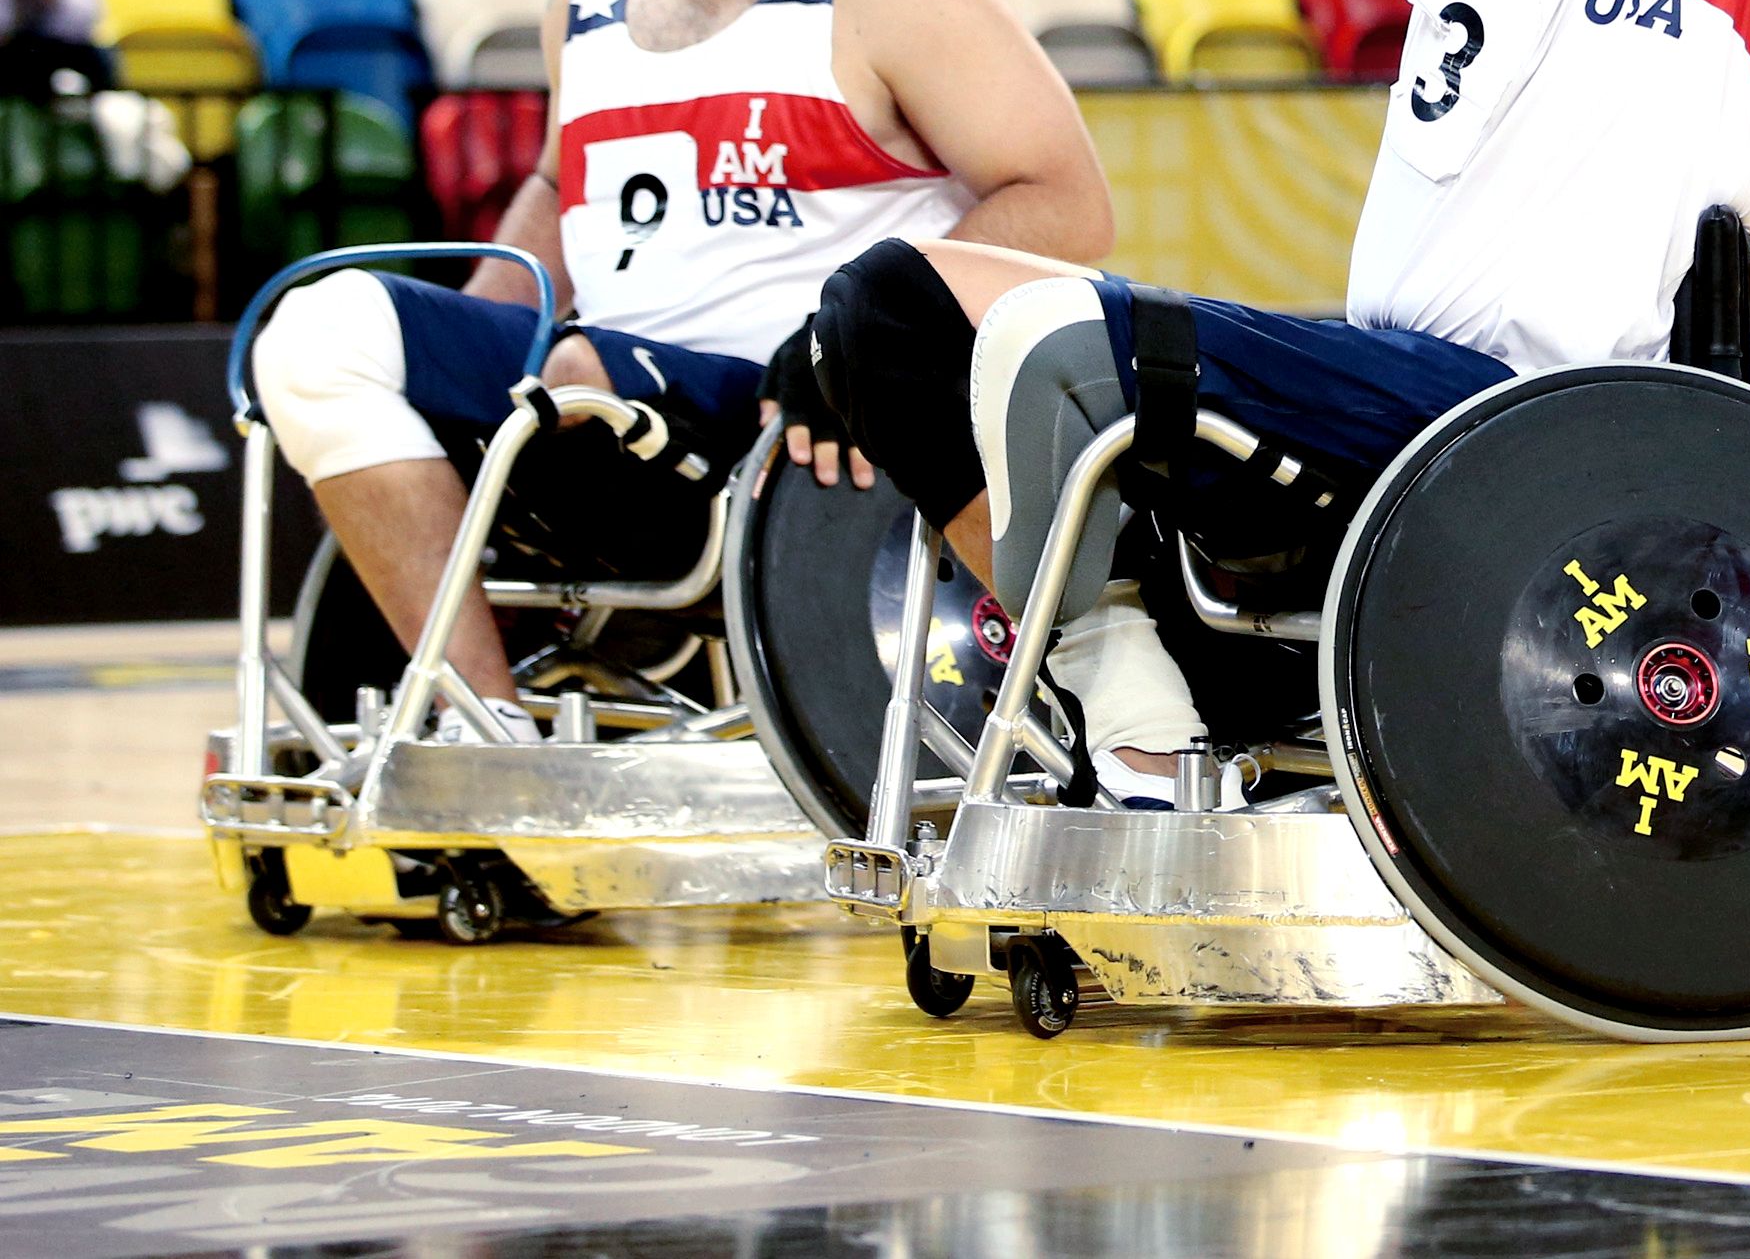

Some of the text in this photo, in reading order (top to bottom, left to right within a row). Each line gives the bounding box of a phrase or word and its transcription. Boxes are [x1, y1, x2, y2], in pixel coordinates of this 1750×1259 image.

[1411, 2, 1485, 122] 3
[744, 98, 767, 139] I
[710, 141, 788, 185] AM
[615, 173, 668, 272] 9
[700, 187, 804, 227] USA
[50, 486, 205, 553] pwc
[1563, 559, 1600, 597] I
[1574, 573, 1648, 650] AM
[1615, 749, 1699, 802] AM
[1634, 795, 1658, 836] I
